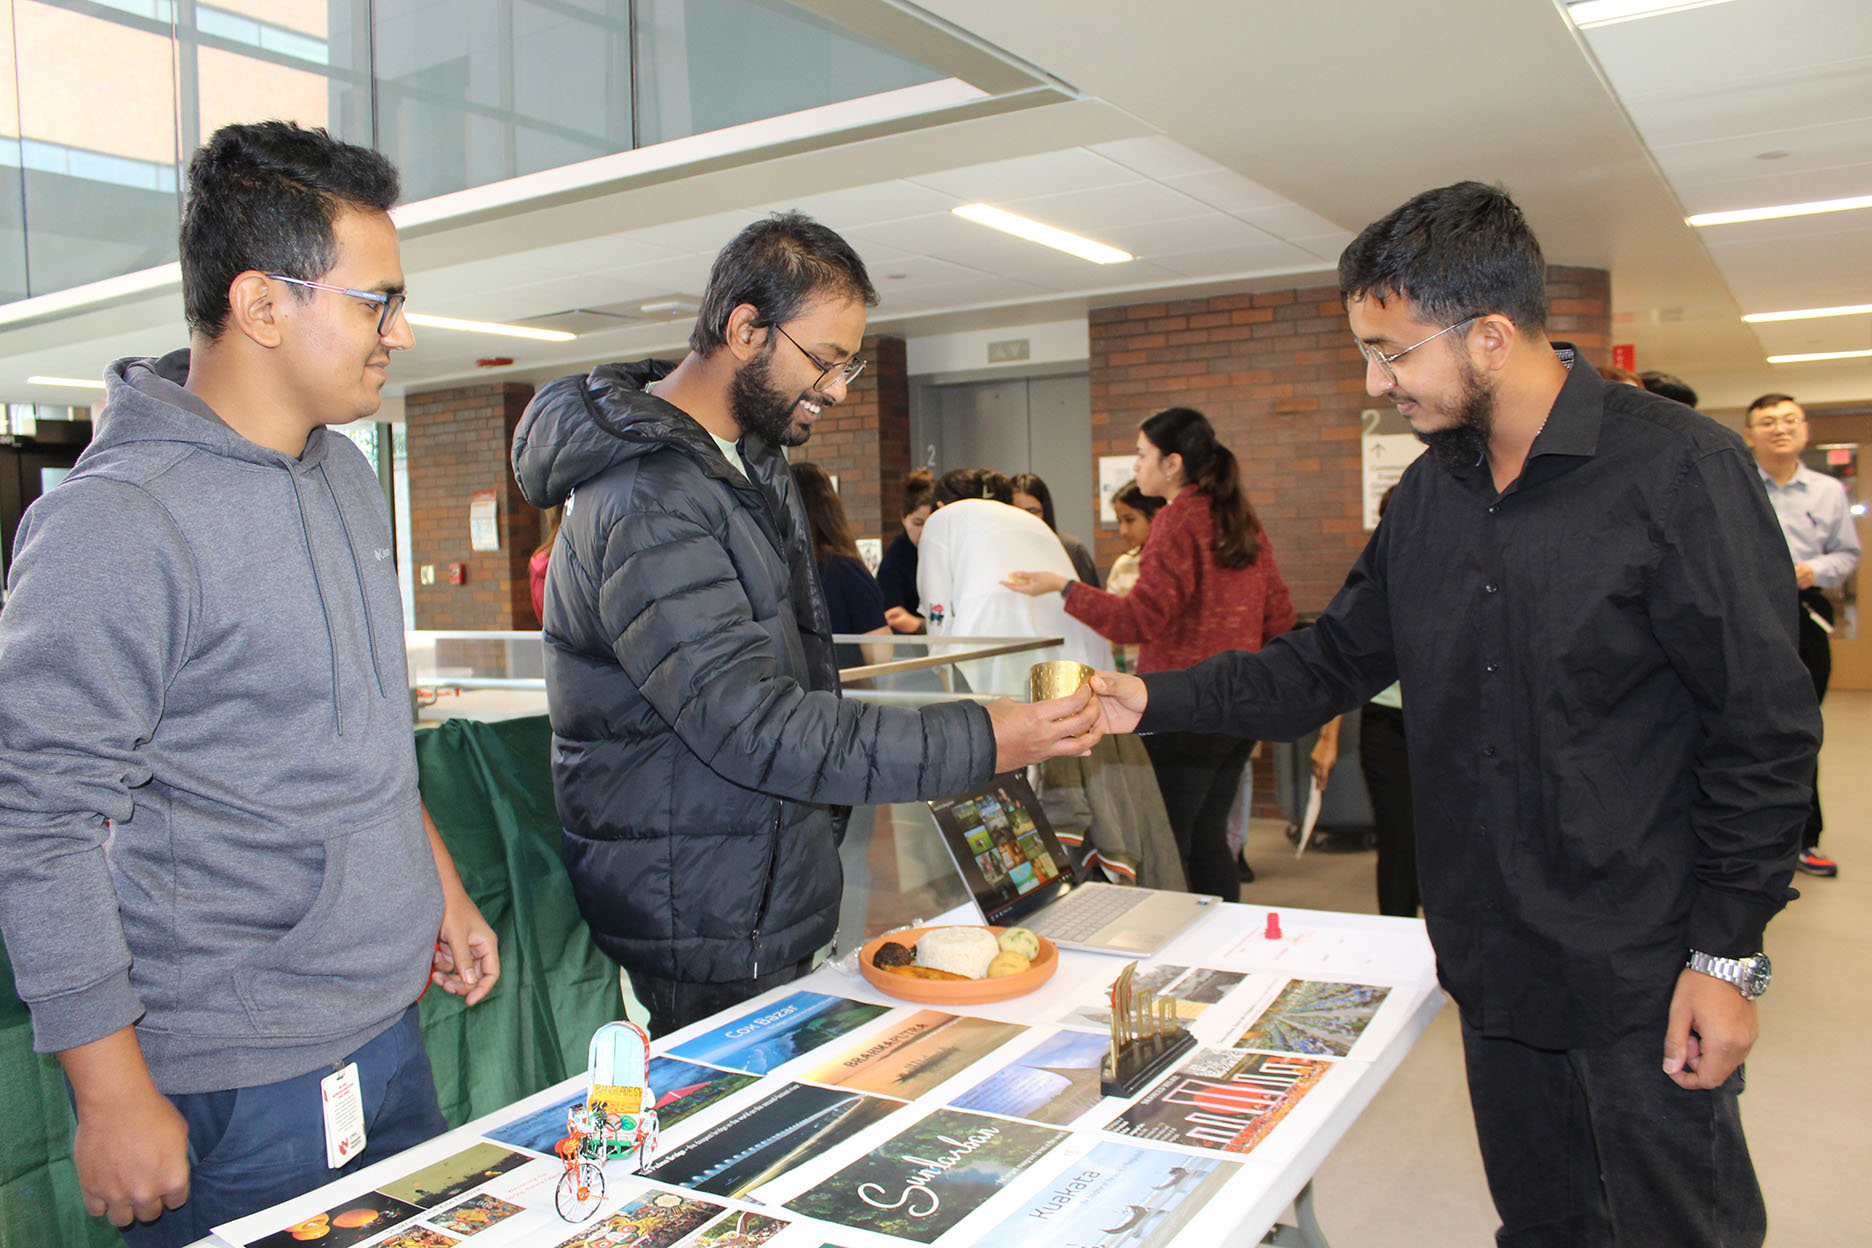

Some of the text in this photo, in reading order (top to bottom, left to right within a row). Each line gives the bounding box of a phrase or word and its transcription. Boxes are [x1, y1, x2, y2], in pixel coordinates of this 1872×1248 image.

[1361, 409, 1380, 435] 2
[927, 443, 936, 467] 2
[725, 1022, 761, 1040] Cox
[754, 1003, 800, 1027] Bazar
[843, 1022, 930, 1069] BRAHMAPUTRA
[857, 1126, 1000, 1218] Sundarban
[1028, 1168, 1101, 1221] Kuakata
